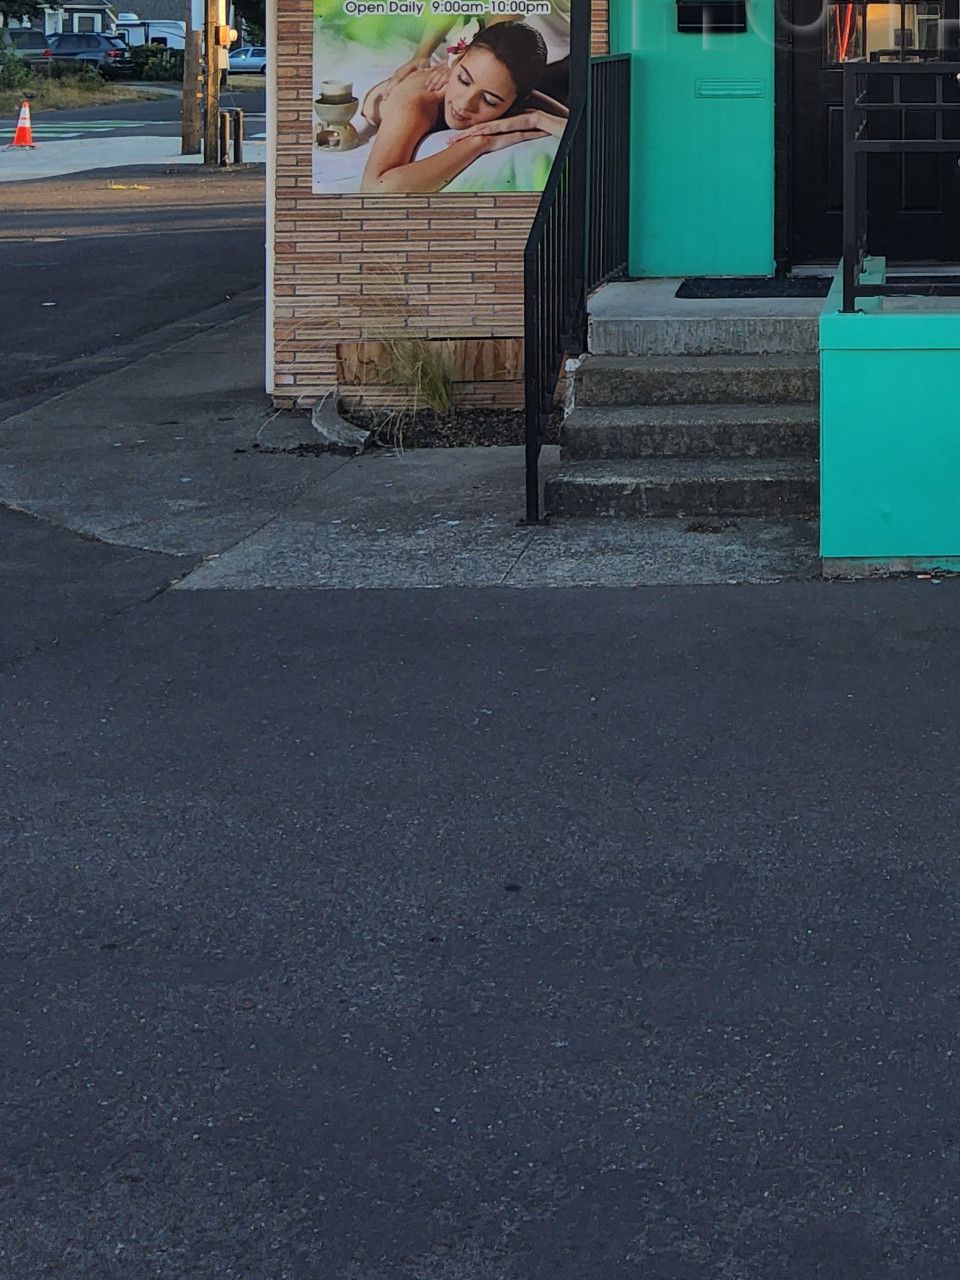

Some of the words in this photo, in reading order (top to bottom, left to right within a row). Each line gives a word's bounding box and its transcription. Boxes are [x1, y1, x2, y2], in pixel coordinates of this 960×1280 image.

[345, 1, 384, 14] Open
[389, 1, 423, 14] Daily
[431, 1, 550, 14] 9:00am-10:00pm
